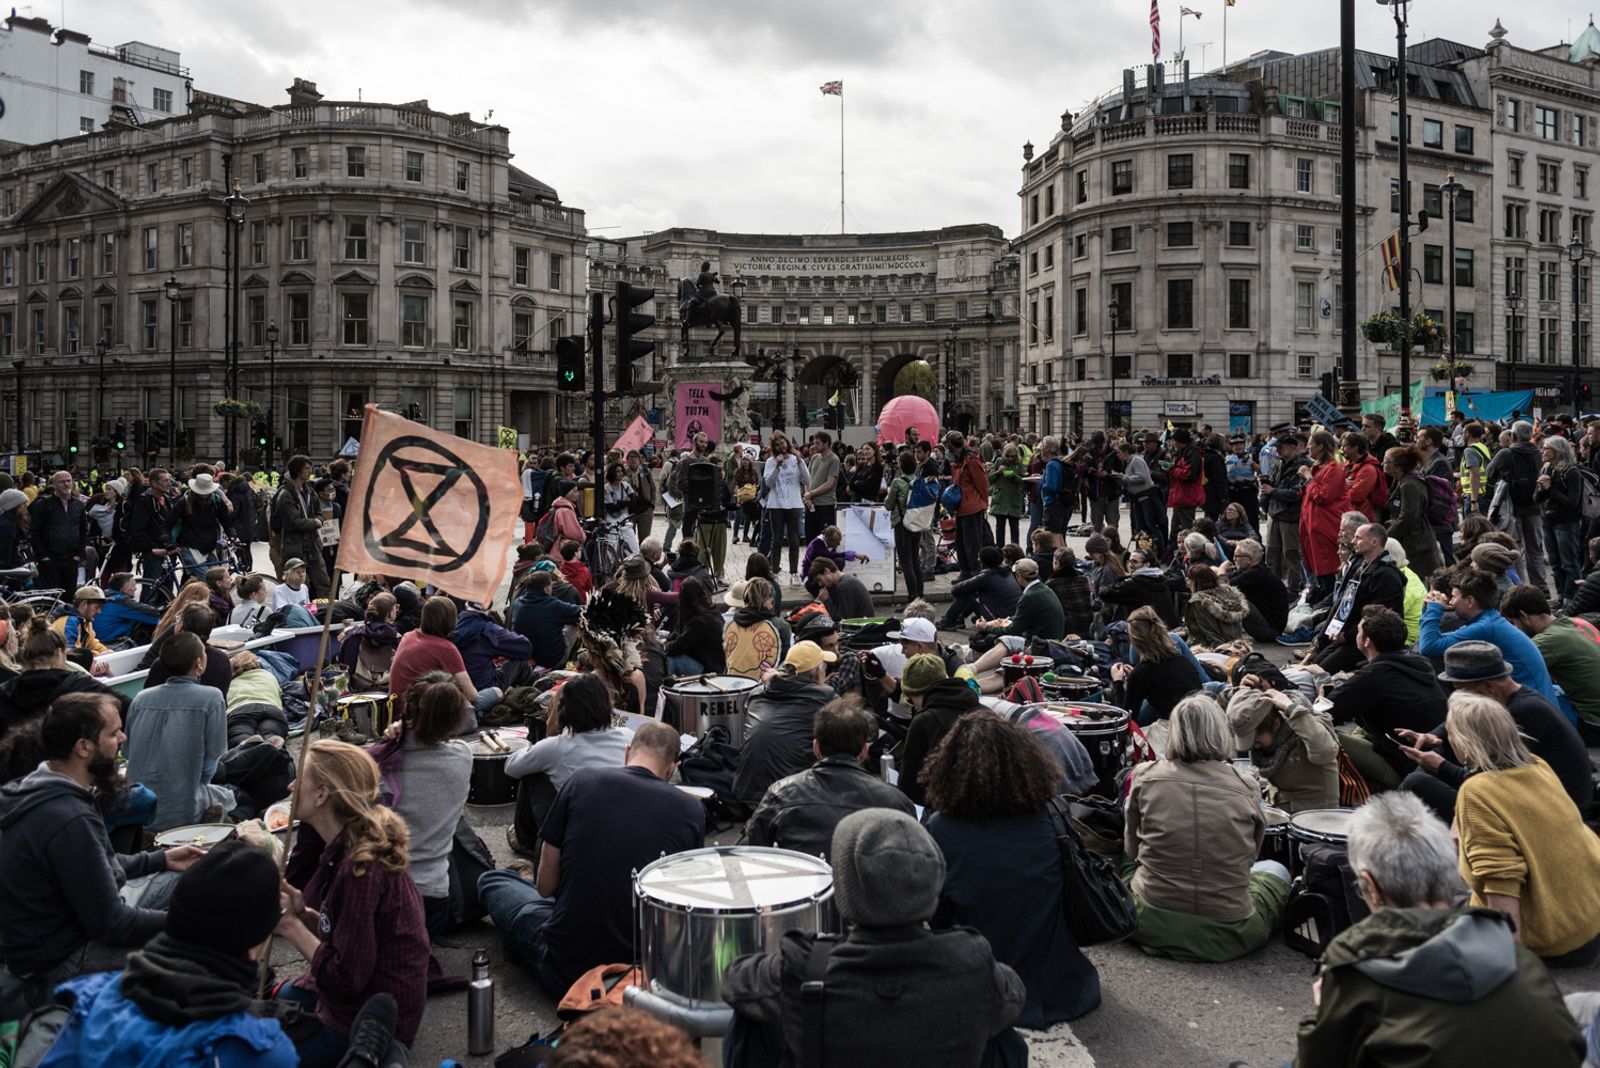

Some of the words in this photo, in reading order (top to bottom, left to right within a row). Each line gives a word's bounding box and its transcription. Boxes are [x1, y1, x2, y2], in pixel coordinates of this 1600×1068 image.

[689, 388, 704, 398] TELL
[685, 406, 709, 416] TRUTH
[700, 700, 739, 716] REBEL
